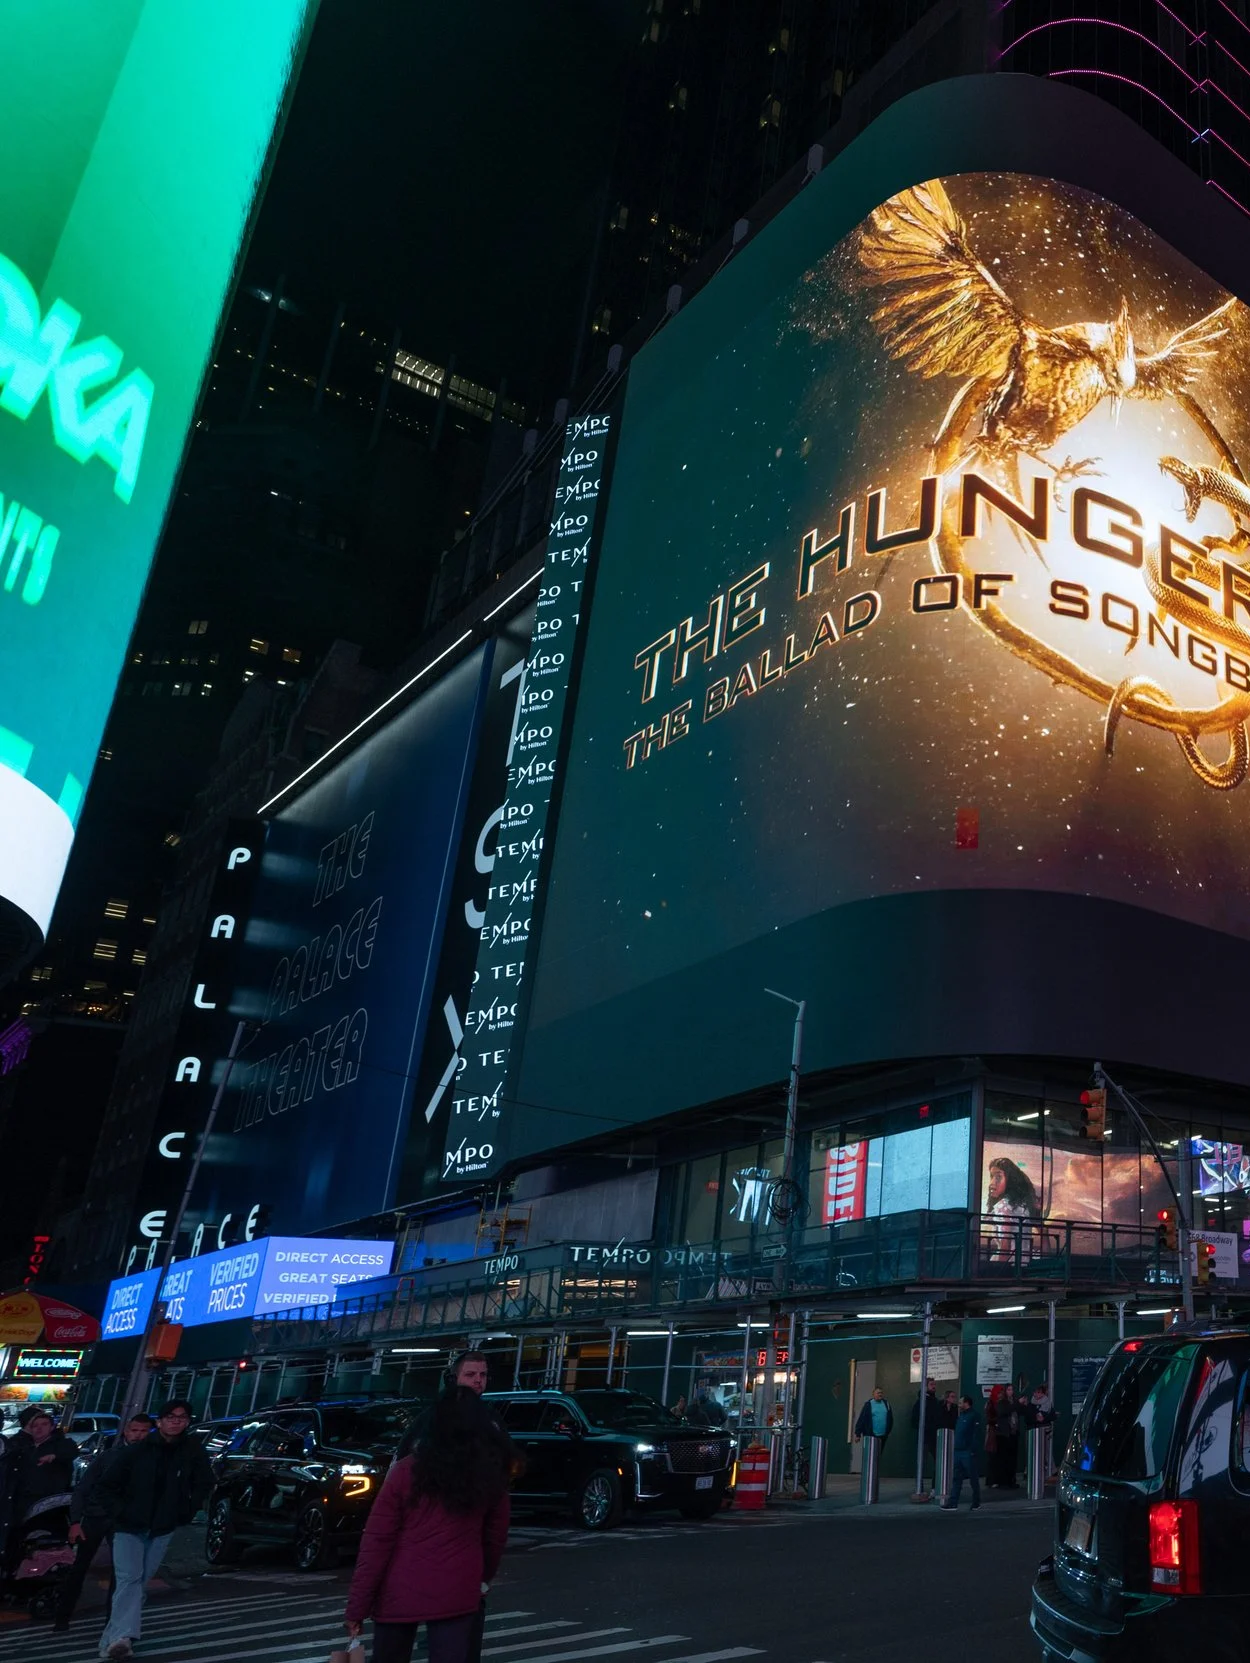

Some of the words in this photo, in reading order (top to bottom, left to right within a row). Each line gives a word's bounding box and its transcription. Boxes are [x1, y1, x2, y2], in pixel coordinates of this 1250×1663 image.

[634, 561, 771, 705] THE
[623, 699, 693, 770] THE
[702, 588, 882, 724] BALLAD
[911, 571, 1016, 614] OF
[529, 702, 550, 711] Hilton
[528, 740, 549, 748] Hilton
[508, 818, 529, 827] Hilton
[312, 810, 375, 908] THE
[261, 896, 383, 1026] PALACE
[233, 1007, 369, 1133] THEATER
[456, 1166, 464, 1174] by
[465, 1161, 489, 1172] Hilton
[124, 1203, 261, 1278] PAACE
[1201, 1233, 1233, 1246] Broadway
[275, 1251, 328, 1263] DIRECT
[330, 1253, 384, 1265] ACCESS
[484, 1248, 520, 1279] TEMPO
[569, 1240, 650, 1268] TEMPO
[209, 1252, 259, 1287] VERIFIED
[278, 1272, 327, 1283] GREAT
[111, 1283, 144, 1310] DIRECT
[207, 1282, 248, 1314] PRICES
[263, 1293, 330, 1304] VERIFIED
[104, 1307, 138, 1334] ACCESS
[19, 1358, 79, 1368] WELCOME
